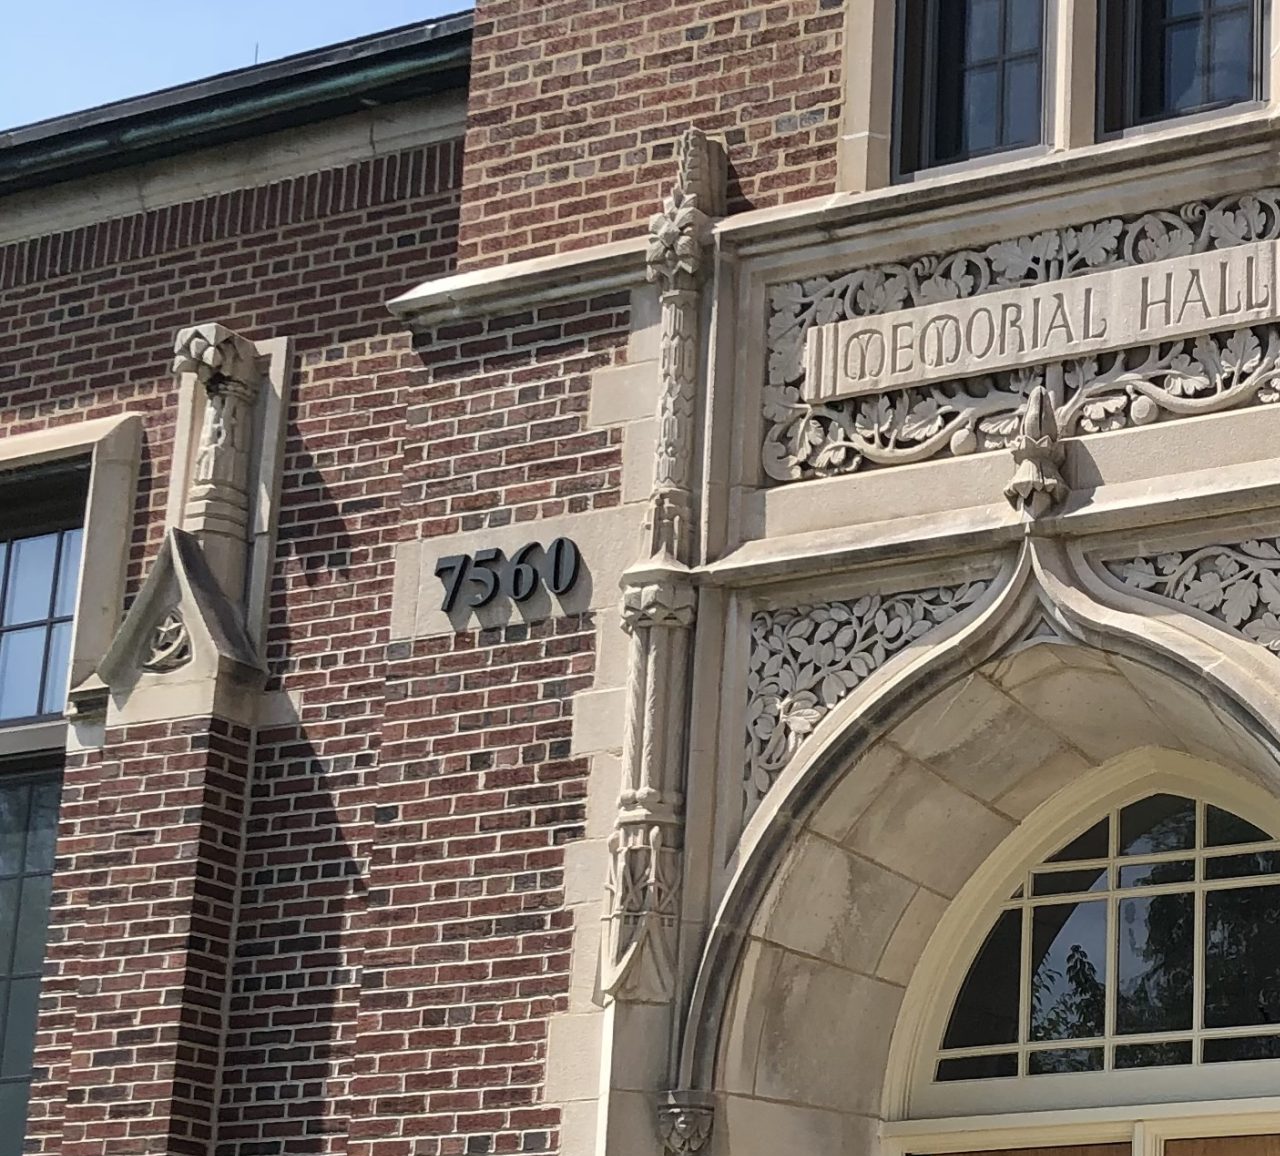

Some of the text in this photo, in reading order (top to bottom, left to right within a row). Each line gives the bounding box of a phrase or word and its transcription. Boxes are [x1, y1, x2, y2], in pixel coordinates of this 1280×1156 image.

[843, 254, 1270, 382] MEMORIAL HALL
[434, 536, 583, 613] 7560
